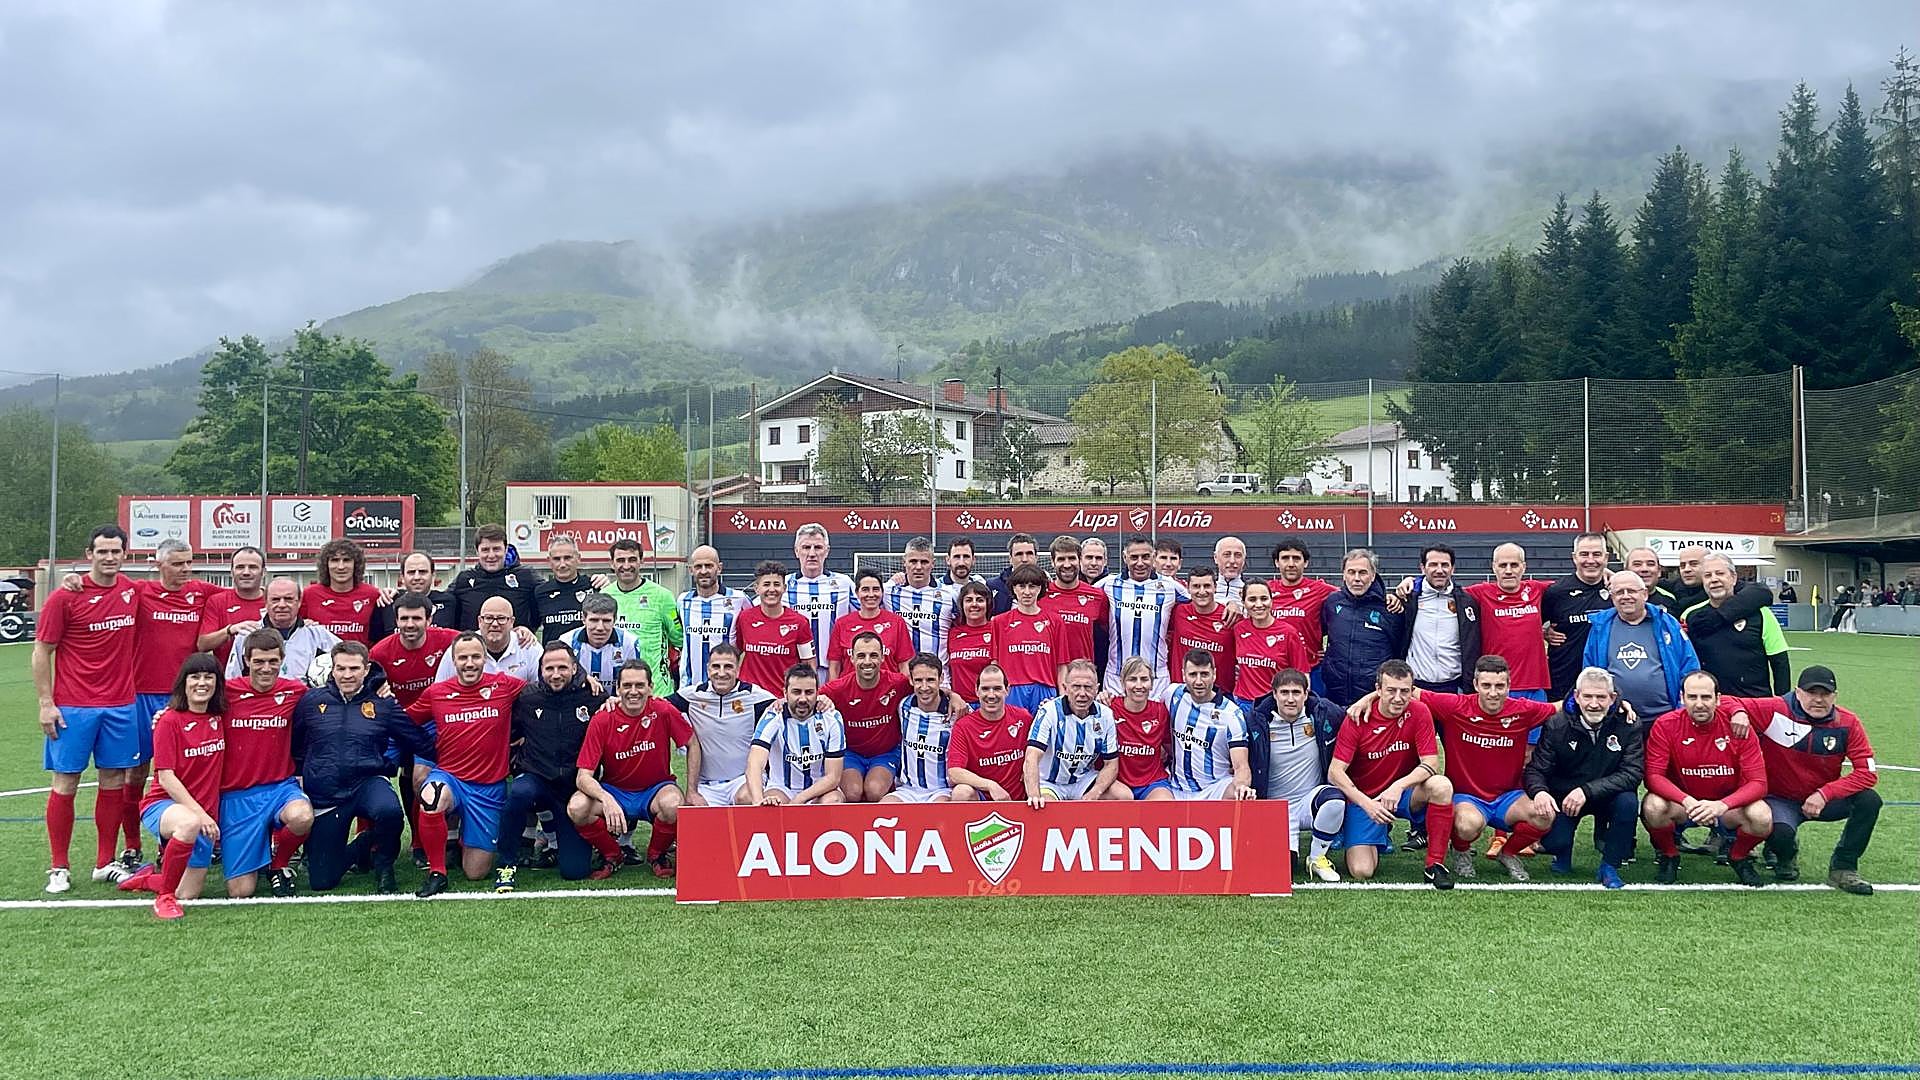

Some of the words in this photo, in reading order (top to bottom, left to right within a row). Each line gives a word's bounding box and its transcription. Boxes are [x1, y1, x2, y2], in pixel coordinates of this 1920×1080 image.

[749, 518, 786, 530] LANA
[863, 518, 900, 530] LANA
[976, 518, 1012, 530] LANA
[1070, 510, 1118, 532] Aupa
[1158, 510, 1212, 528] Aloña
[1296, 518, 1334, 530] LANA
[1419, 520, 1456, 530] LANA
[1541, 519, 1578, 530] LANA
[277, 525, 328, 533] EGUZKIALDE
[546, 611, 582, 624] taupadi
[1062, 612, 1089, 624] padia
[1271, 608, 1305, 617] upadia
[445, 708, 498, 722] taupadia
[1462, 732, 1513, 747] taupadia
[1118, 745, 1154, 756] upadia
[1682, 765, 1734, 778] taupadia
[738, 817, 953, 876] ALOÑA
[1042, 828, 1232, 872] MENDI
[968, 879, 1021, 896] 1949
